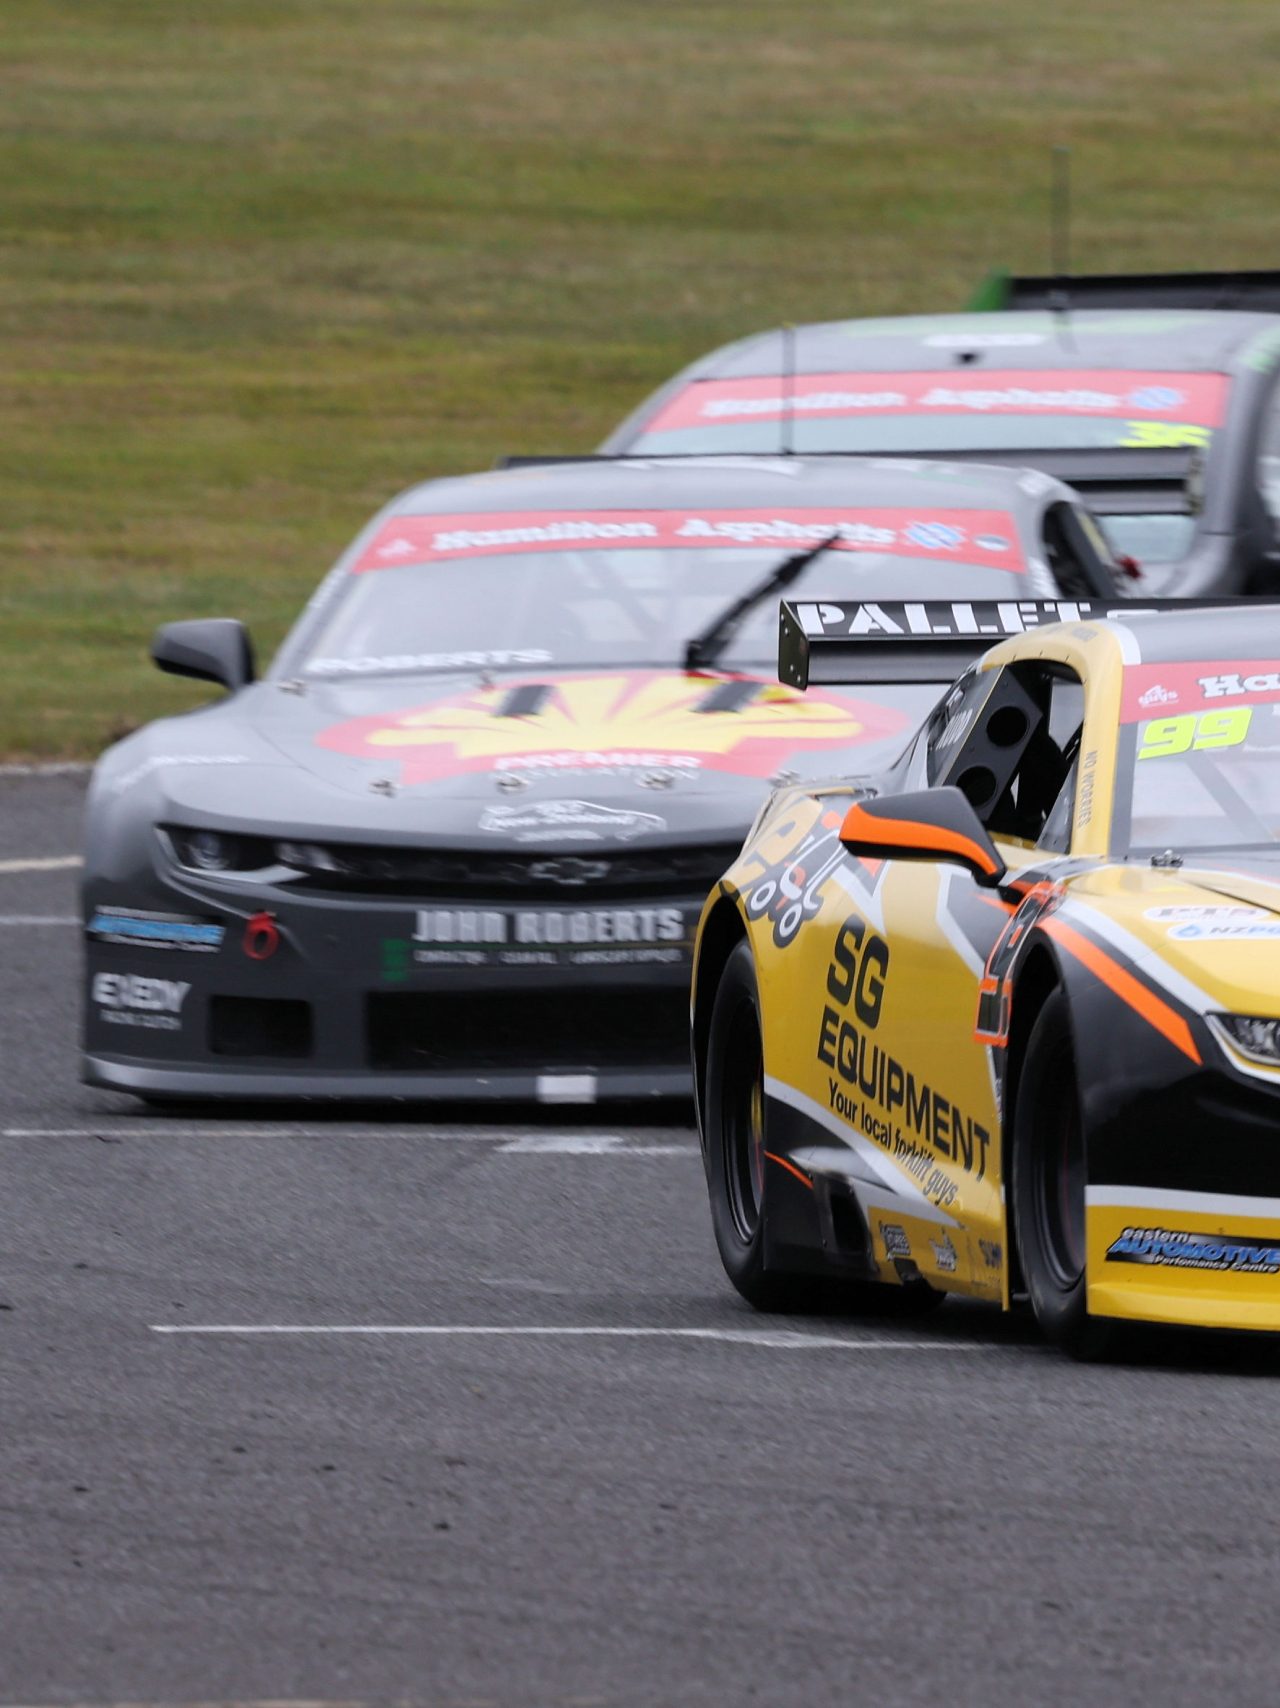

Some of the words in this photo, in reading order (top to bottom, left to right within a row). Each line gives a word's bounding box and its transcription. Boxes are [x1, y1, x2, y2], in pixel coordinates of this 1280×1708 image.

[797, 603, 1091, 634] PALLET
[1137, 709, 1253, 761] 99
[412, 909, 508, 943] JOHN
[513, 908, 685, 943] ROBERTS
[827, 913, 889, 1030] SG
[817, 1004, 990, 1182] EQUIPMENT
[828, 1076, 859, 1124] Your
[861, 1102, 892, 1151] local
[894, 1127, 935, 1184] forklift
[921, 1160, 960, 1207] guys
[1121, 1228, 1188, 1243] eastern
